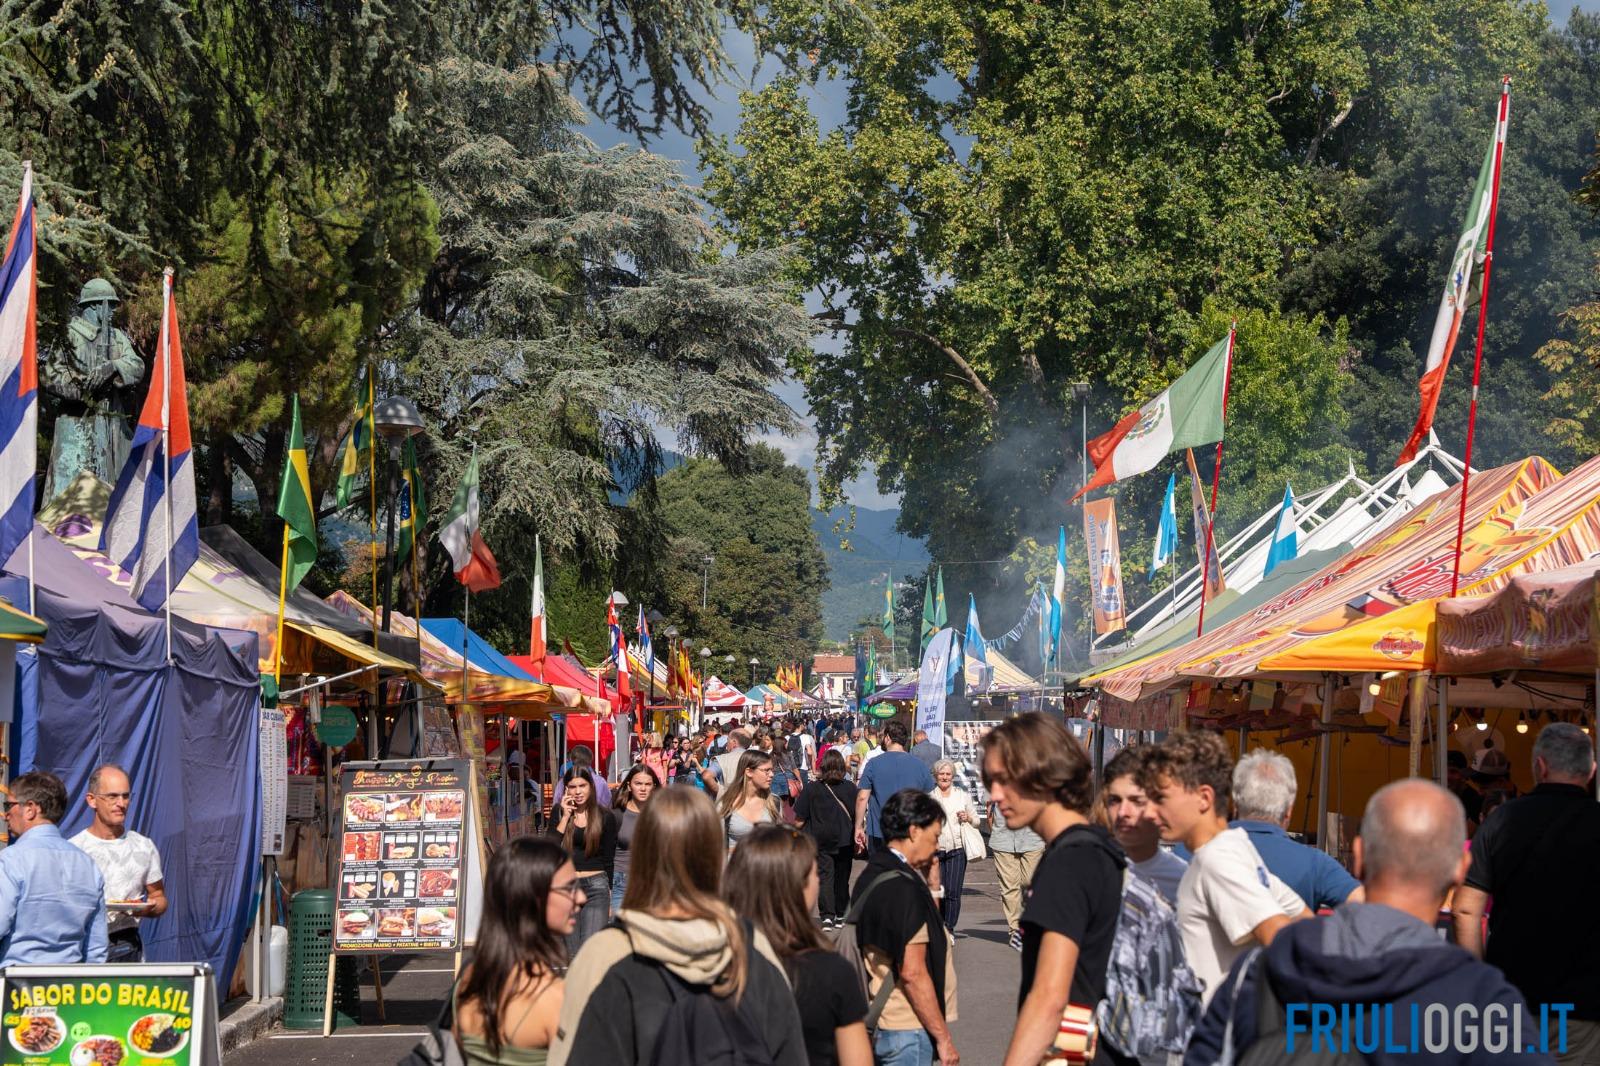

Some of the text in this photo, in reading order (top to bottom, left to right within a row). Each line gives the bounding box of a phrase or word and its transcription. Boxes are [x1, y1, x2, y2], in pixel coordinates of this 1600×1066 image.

[10, 982, 192, 1014] SABOR DO BRASIL
